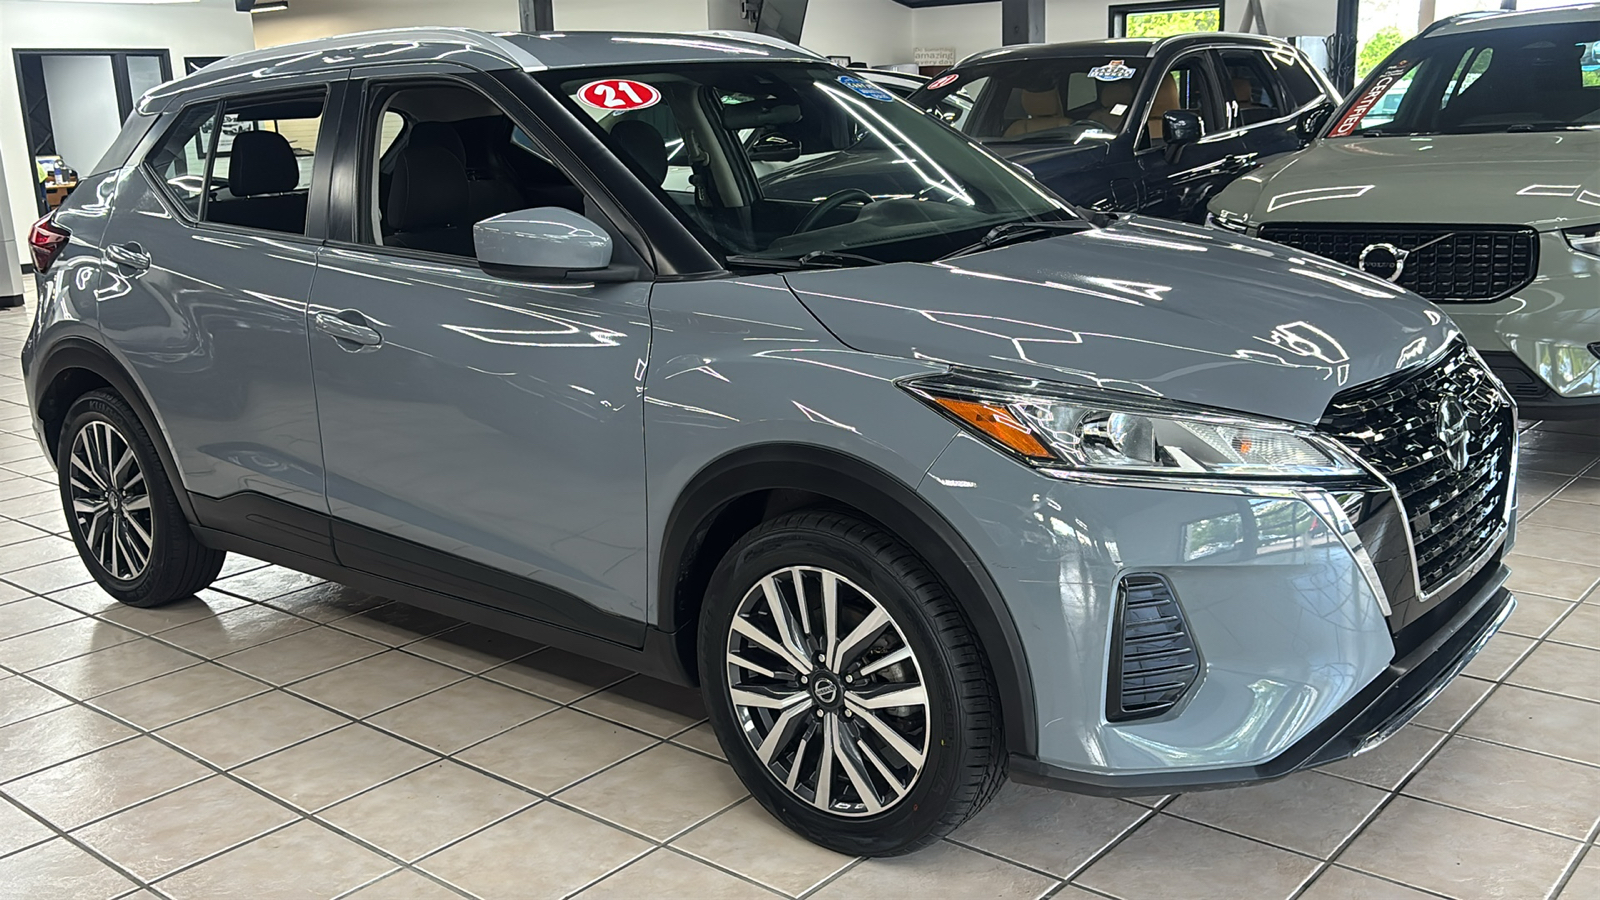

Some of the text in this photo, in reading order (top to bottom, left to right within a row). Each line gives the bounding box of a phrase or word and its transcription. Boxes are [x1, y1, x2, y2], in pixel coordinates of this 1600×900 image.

[915, 51, 953, 60] amazing
[593, 82, 643, 107] 21
[1337, 76, 1393, 133] CERTIFIED
